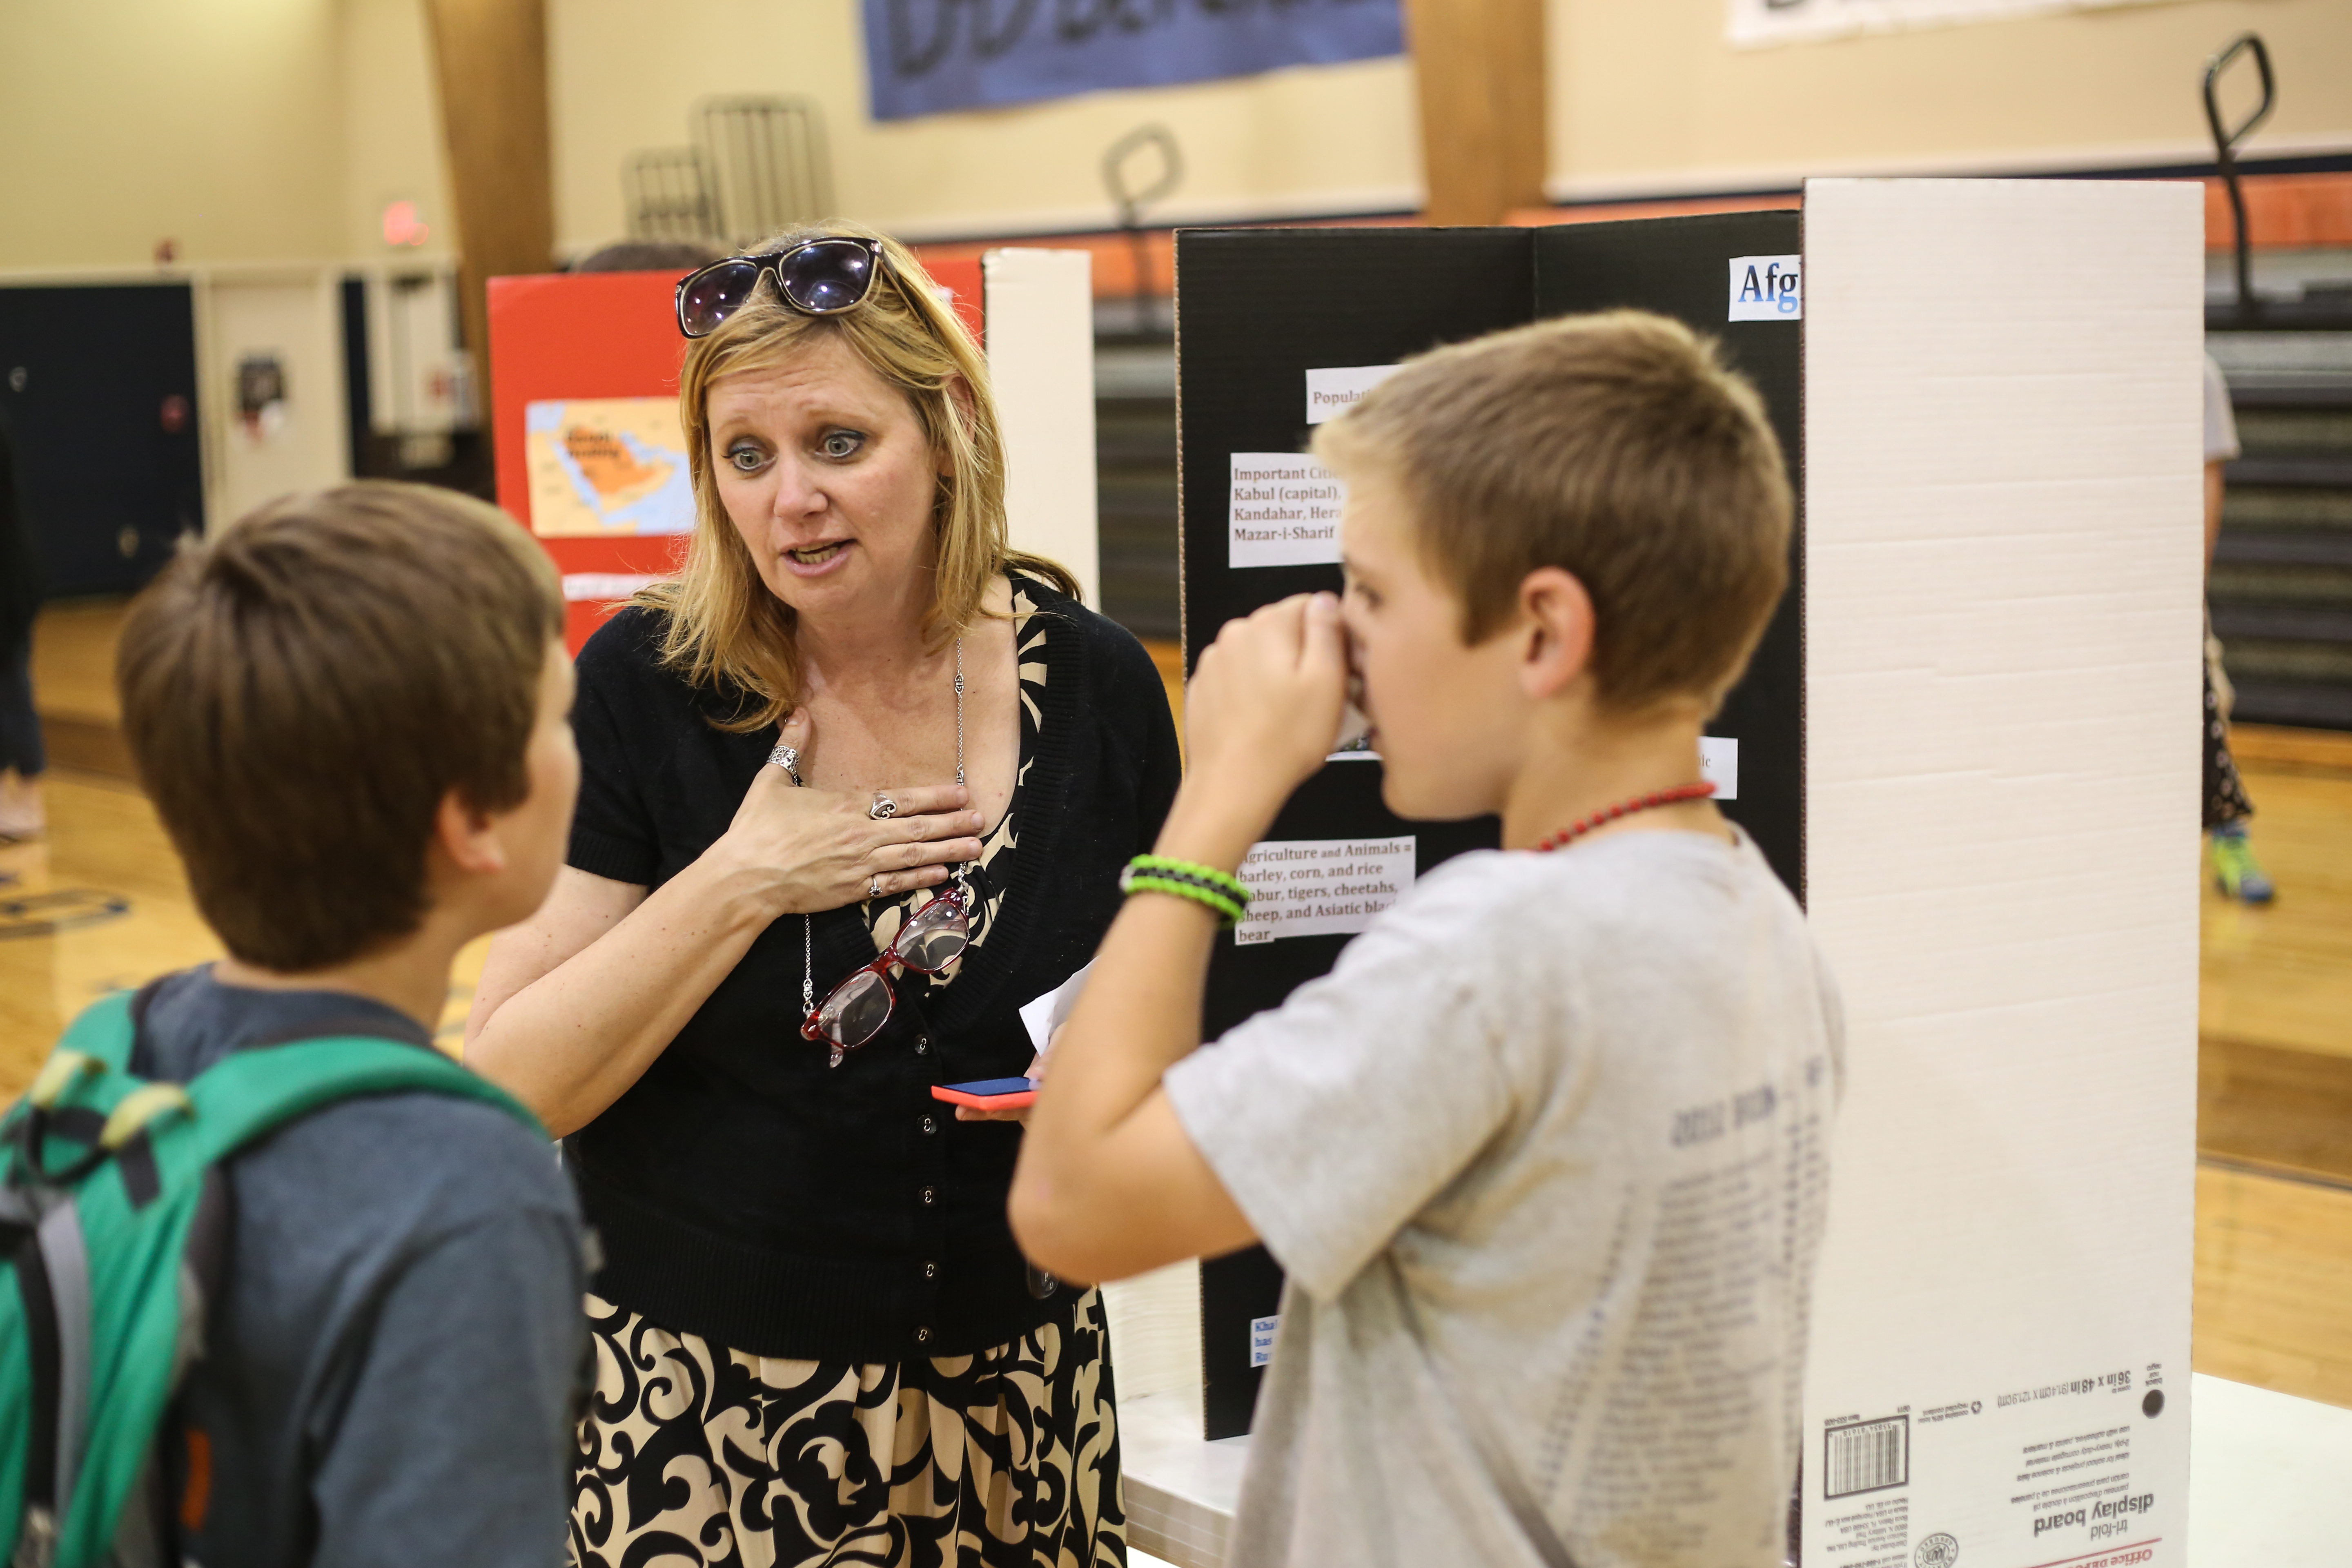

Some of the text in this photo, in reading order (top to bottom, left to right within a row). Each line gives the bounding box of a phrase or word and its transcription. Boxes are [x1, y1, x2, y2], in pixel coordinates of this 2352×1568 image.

[1738, 262, 1801, 313] Afg
[1314, 389, 1370, 406] Populat
[1234, 468, 1305, 483] Important
[1235, 487, 1274, 501] Kabul
[1235, 507, 1306, 521] Kandahar,
[1235, 526, 1335, 541] Mazar-i-Sharif
[1321, 847, 1341, 858] and
[1345, 841, 1400, 856] Animals
[1239, 862, 1383, 884] barley, corn, and rice
[1288, 886, 1331, 902] tigers,
[1334, 881, 1398, 896] cheetahs,
[1286, 905, 1311, 919] and
[1315, 902, 1361, 916] Asiatic
[1239, 929, 1270, 942] bear
[2098, 1376, 2104, 1387] x
[2145, 1377, 2163, 1387] black
[2062, 1461, 2086, 1472] projects
[2087, 1458, 2106, 1467] school
[2031, 1468, 2055, 1479] science
[2096, 1476, 2110, 1486] para
[2104, 1483, 2129, 1495] panneau
[2042, 1499, 2062, 1510] double
[2034, 1493, 2154, 1538] display board
[2090, 1519, 2128, 1541] tri-fold
[2111, 1549, 2153, 1566] Office
